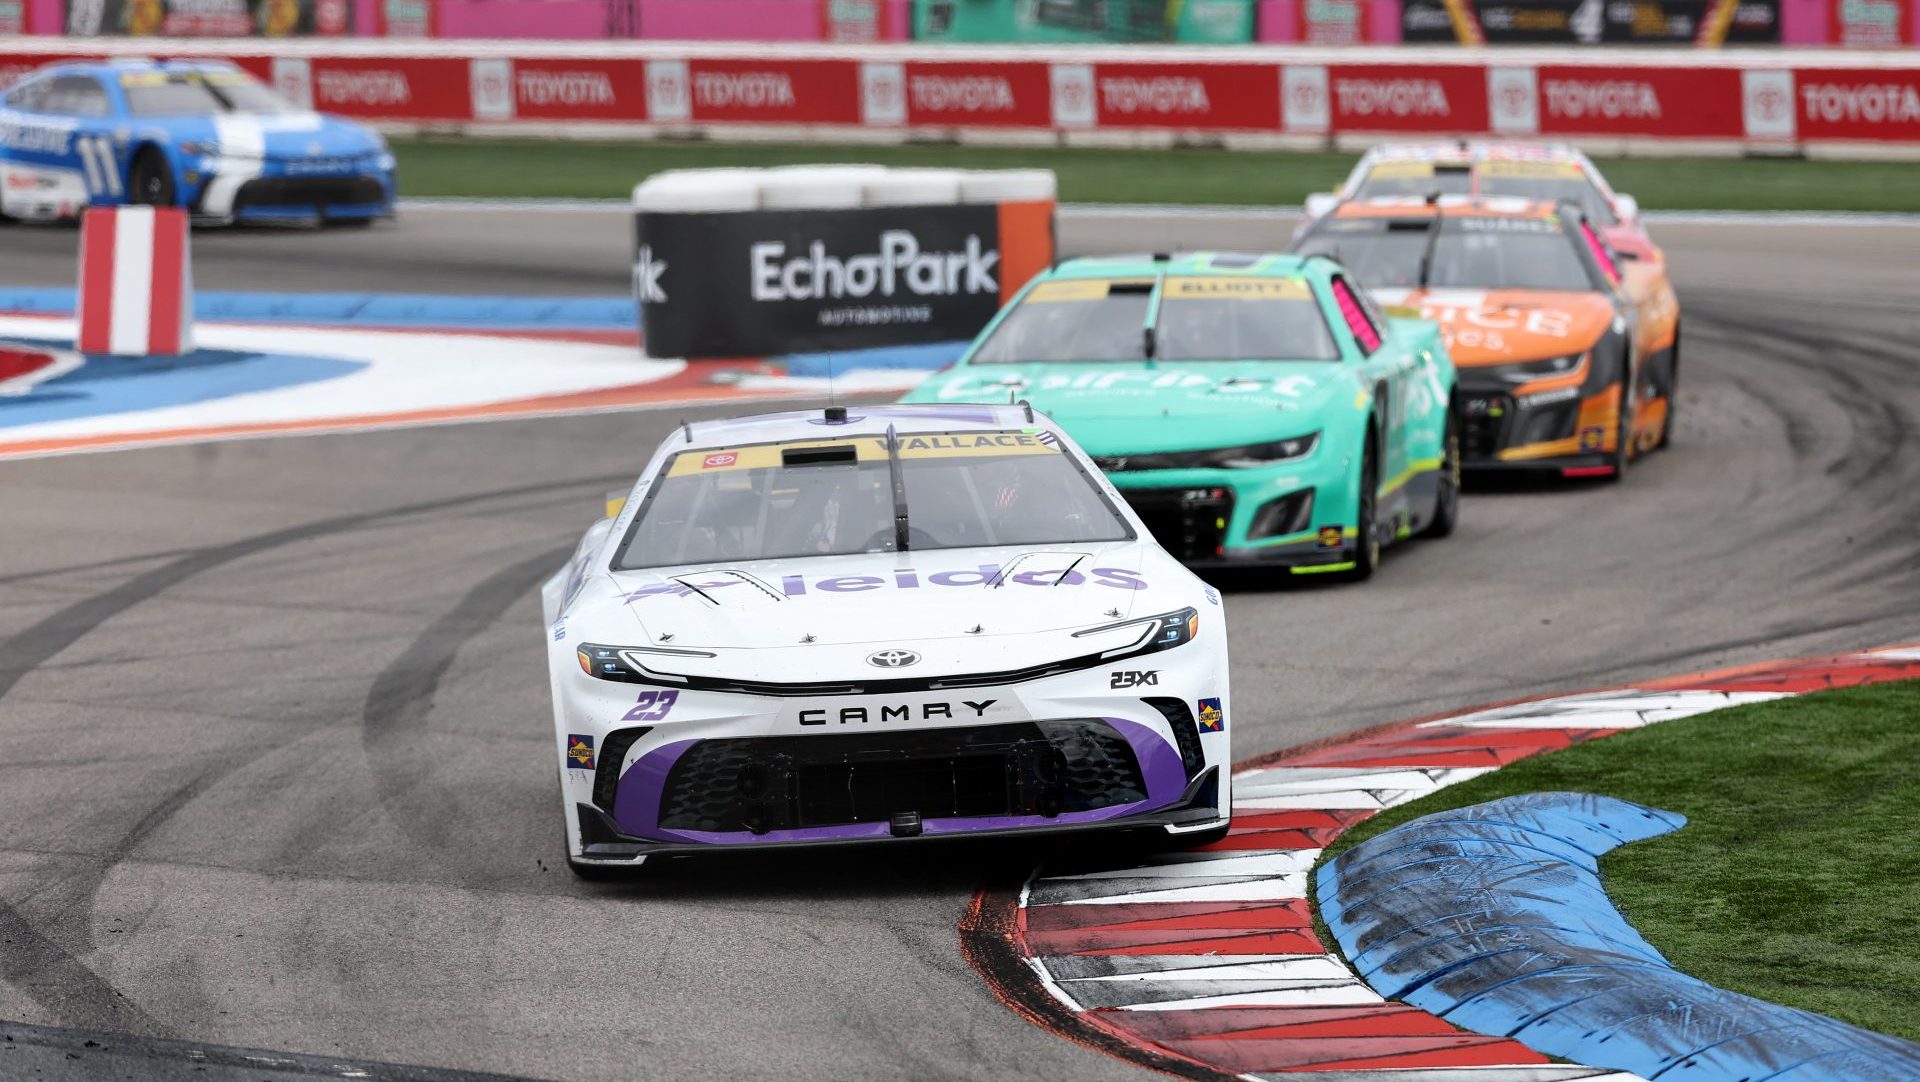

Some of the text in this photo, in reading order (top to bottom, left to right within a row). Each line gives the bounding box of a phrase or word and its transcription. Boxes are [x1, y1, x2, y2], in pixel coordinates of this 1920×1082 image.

[317, 71, 412, 105] TOYOTA
[517, 72, 615, 106] TOYOTA
[694, 73, 795, 107] TOYOTA
[911, 75, 1015, 111] TOYOTA
[1100, 76, 1210, 112] TOYOTA
[1336, 79, 1450, 117] TOYOTA
[1544, 81, 1662, 119] TOYOTA
[1801, 83, 1920, 122] TOYOTA
[78, 136, 125, 198] 11
[750, 229, 1000, 301] EchoPark
[1181, 281, 1283, 293] ELLIOTT
[817, 305, 933, 326] AUTOMOTIVE
[875, 434, 1036, 451] WALLACE
[782, 562, 1148, 597] leidos
[620, 689, 680, 722] 23
[799, 699, 998, 726] CAMRY
[1199, 710, 1221, 723] SUNOCO
